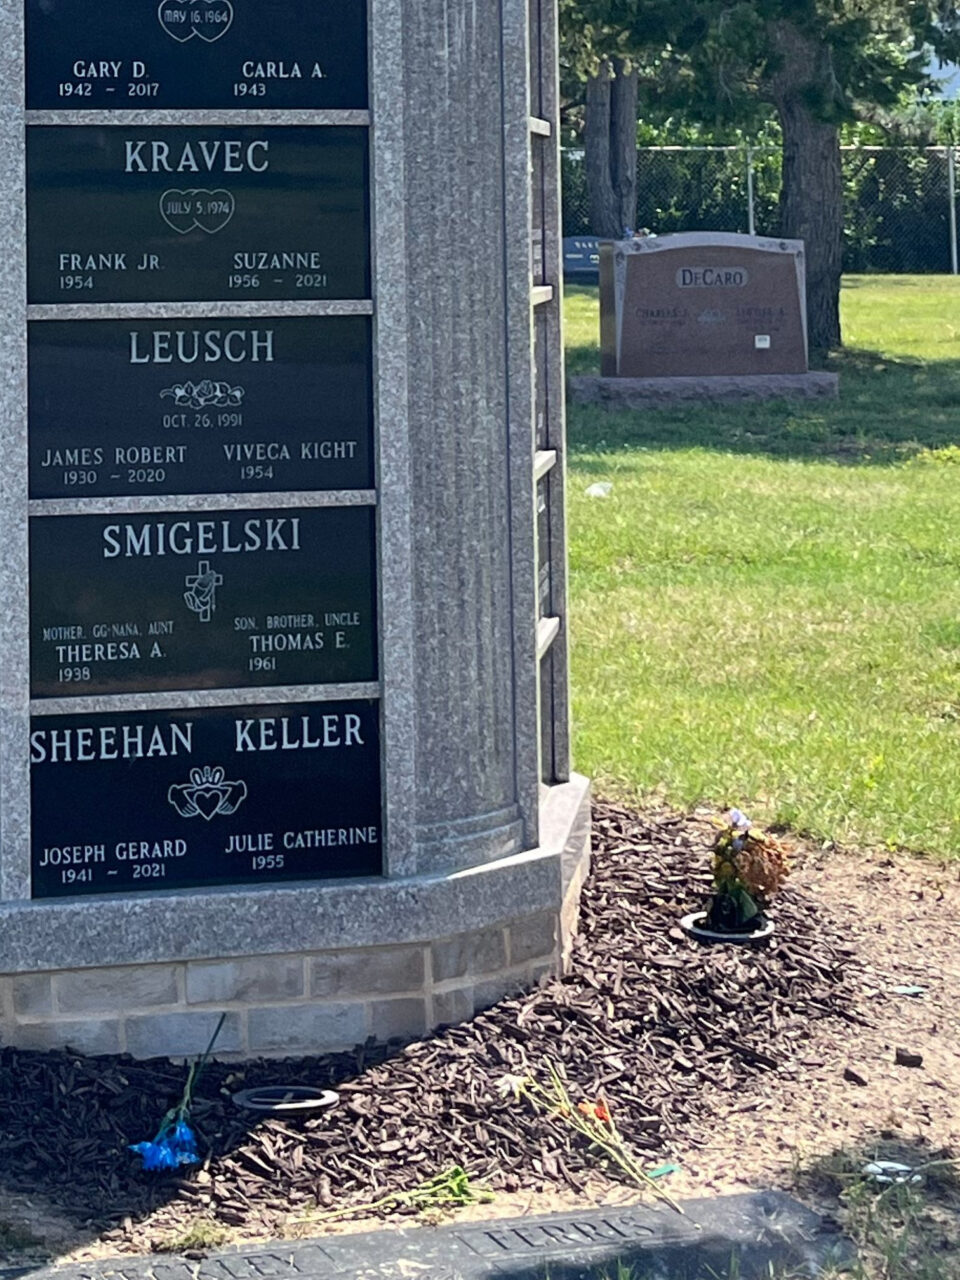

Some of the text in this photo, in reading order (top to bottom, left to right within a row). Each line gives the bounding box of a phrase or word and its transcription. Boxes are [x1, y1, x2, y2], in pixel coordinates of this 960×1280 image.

[164, 10, 187, 23] MAY
[74, 61, 122, 78] GARY
[242, 62, 327, 78] CARLA A.
[59, 83, 92, 96] 1942
[128, 83, 159, 96] 2017
[234, 83, 266, 96] 1943
[124, 141, 269, 172] KRAVEC
[166, 201, 191, 214] JULY
[59, 253, 126, 270] FRANK
[234, 252, 320, 269] SUZANNE
[60, 276, 93, 289] 1954
[228, 275, 260, 288] 1956
[295, 274, 327, 287] 2021
[130, 330, 274, 363] LEUSCH
[163, 414, 191, 428] OCT.
[218, 413, 242, 427] 1991
[41, 446, 187, 466] JAMES ROBERT
[224, 441, 357, 461] VIVECA KIGHT
[64, 471, 97, 484] 1930
[128, 470, 165, 483] 2020
[241, 467, 274, 480] 1954
[103, 518, 301, 557] SMIGELSKI
[325, 612, 360, 626] UNCLE
[148, 621, 174, 635] AUNT
[249, 632, 350, 652] THOMAS E.
[56, 641, 166, 663] THERESA A.
[249, 658, 276, 671] 1961
[59, 668, 90, 682] 1938
[31, 714, 364, 763] SHEEHAN KELLER
[225, 827, 378, 854] JULIE CATHERINE
[39, 839, 187, 866] JOSEPH GERARD
[252, 855, 284, 870] 1955
[62, 869, 92, 883] 1941
[132, 864, 165, 878] 2021
[483, 1215, 654, 1250] FERRIS
[78, 1253, 302, 1280] ECKLEY
